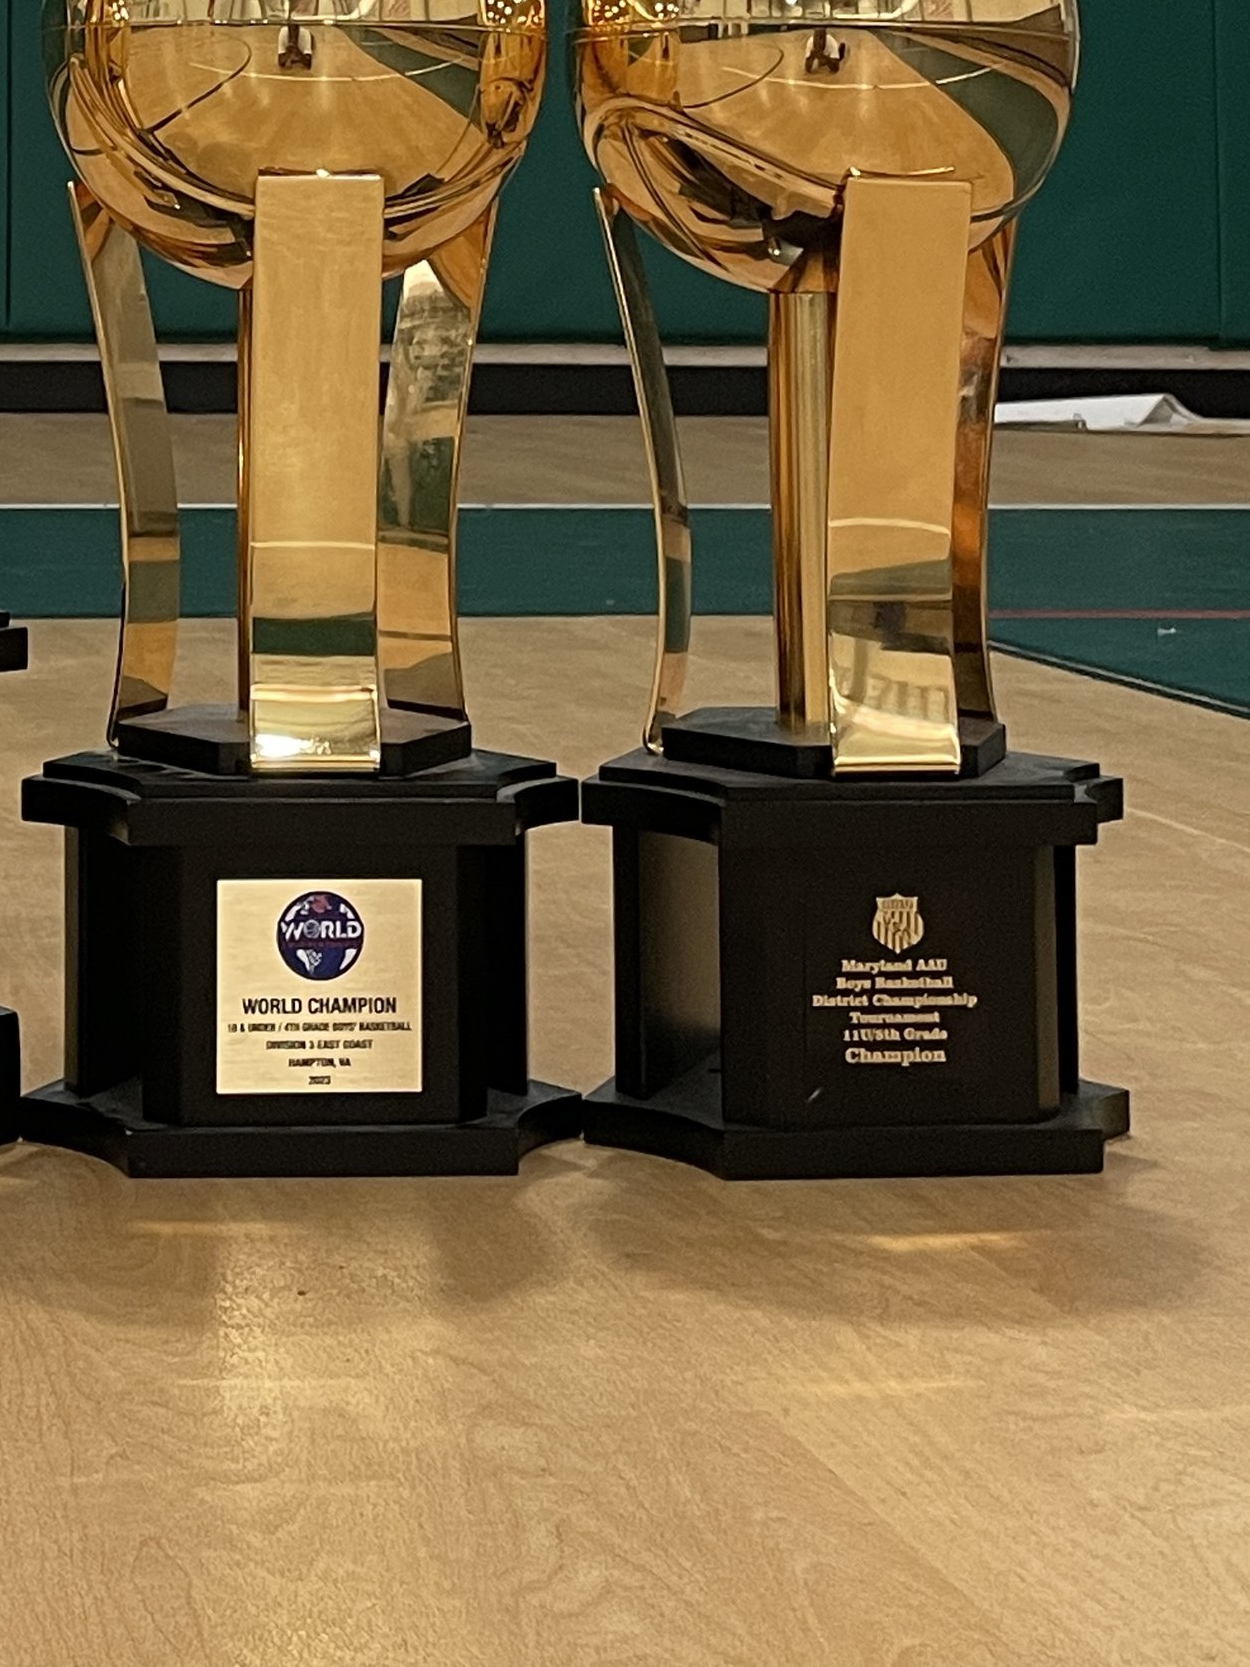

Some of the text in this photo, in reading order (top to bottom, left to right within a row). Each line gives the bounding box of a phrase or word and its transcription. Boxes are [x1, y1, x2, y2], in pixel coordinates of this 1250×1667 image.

[280, 919, 362, 941] WORLD
[842, 959, 948, 974] Maryland AAU
[836, 976, 954, 991] Boys Basketball
[241, 996, 398, 1015] WORLD CHAMPION
[812, 993, 978, 1008] District Championship
[849, 1011, 940, 1023] Tournament
[904, 1027, 948, 1041] Grade
[317, 1039, 341, 1050] EAST
[342, 1039, 374, 1050] COAST
[845, 1047, 947, 1066] Champion
